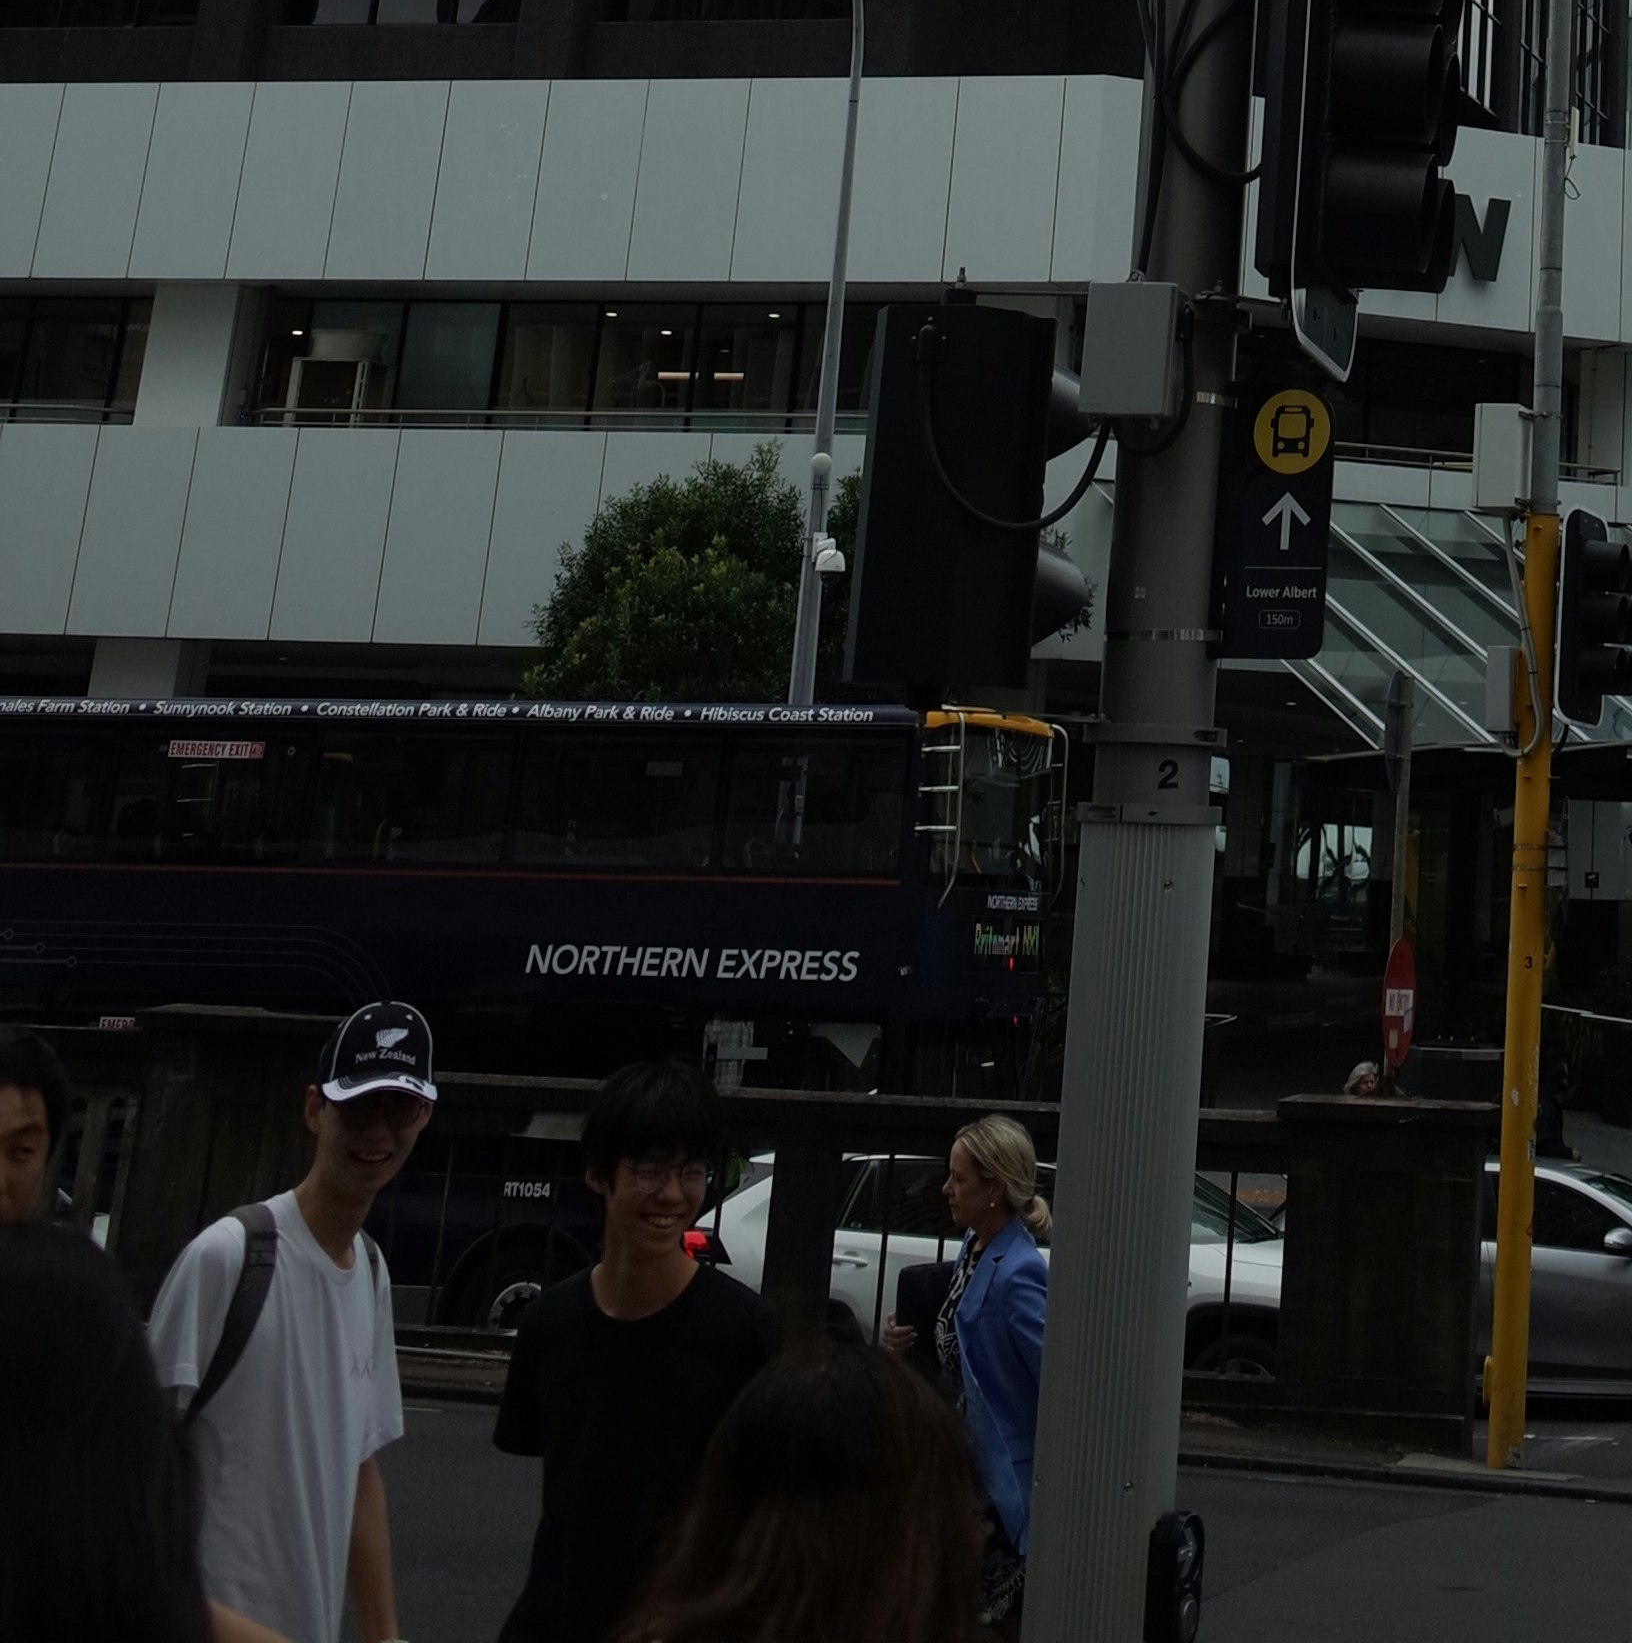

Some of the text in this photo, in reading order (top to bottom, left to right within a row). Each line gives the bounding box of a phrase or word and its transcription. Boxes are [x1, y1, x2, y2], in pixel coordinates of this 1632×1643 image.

[1245, 585, 1318, 598] Lower Albert
[1266, 613, 1294, 625] 150m
[36, 699, 75, 713] Farm
[77, 700, 130, 715] Station
[153, 701, 235, 717] Sunnynook
[237, 702, 292, 716] Station
[316, 702, 417, 717] Constellation
[418, 703, 453, 717] Park
[455, 704, 468, 717] &
[472, 703, 507, 717] Ride
[525, 704, 582, 722] Albany
[584, 705, 619, 720] Park
[622, 706, 635, 719] &
[639, 706, 675, 721] Ride
[700, 706, 765, 722] Hibiscus
[768, 707, 814, 722] Coast
[816, 708, 874, 722] Station
[170, 742, 227, 756] EMERGENCY
[229, 744, 250, 757] EXIT
[1158, 760, 1178, 788] 2
[525, 944, 861, 982] NORTHERN EXPRESS
[1525, 956, 1532, 969] 3
[355, 1048, 416, 1066] New Zealand
[503, 1180, 551, 1198] RT1054
